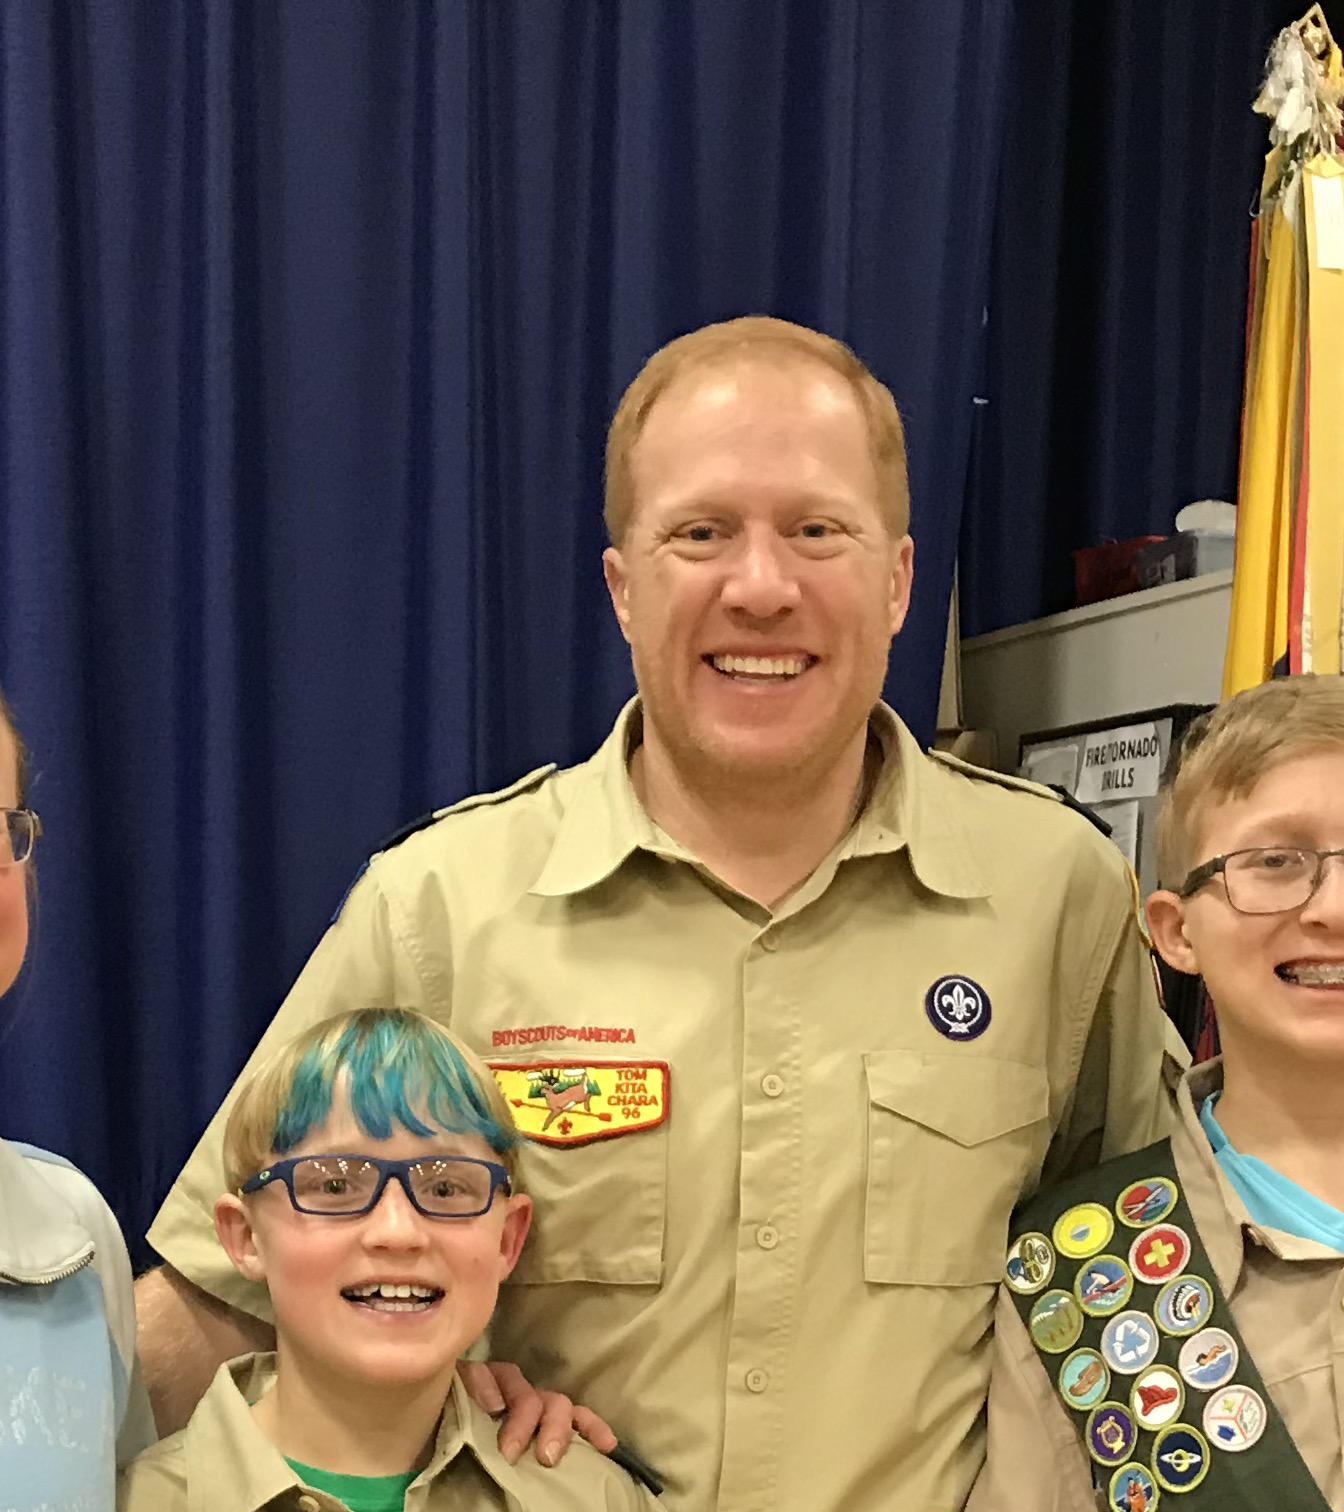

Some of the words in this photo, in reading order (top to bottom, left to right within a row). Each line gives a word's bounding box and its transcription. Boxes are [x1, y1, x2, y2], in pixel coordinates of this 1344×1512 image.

[492, 1028, 517, 1046] BOY
[518, 1025, 565, 1044] SCOUTS
[577, 1027, 636, 1044] AMERICA
[616, 1070, 647, 1081] TOM
[614, 1083, 648, 1094] KITA
[607, 1095, 659, 1106] CHARA
[621, 1107, 641, 1119] 96
